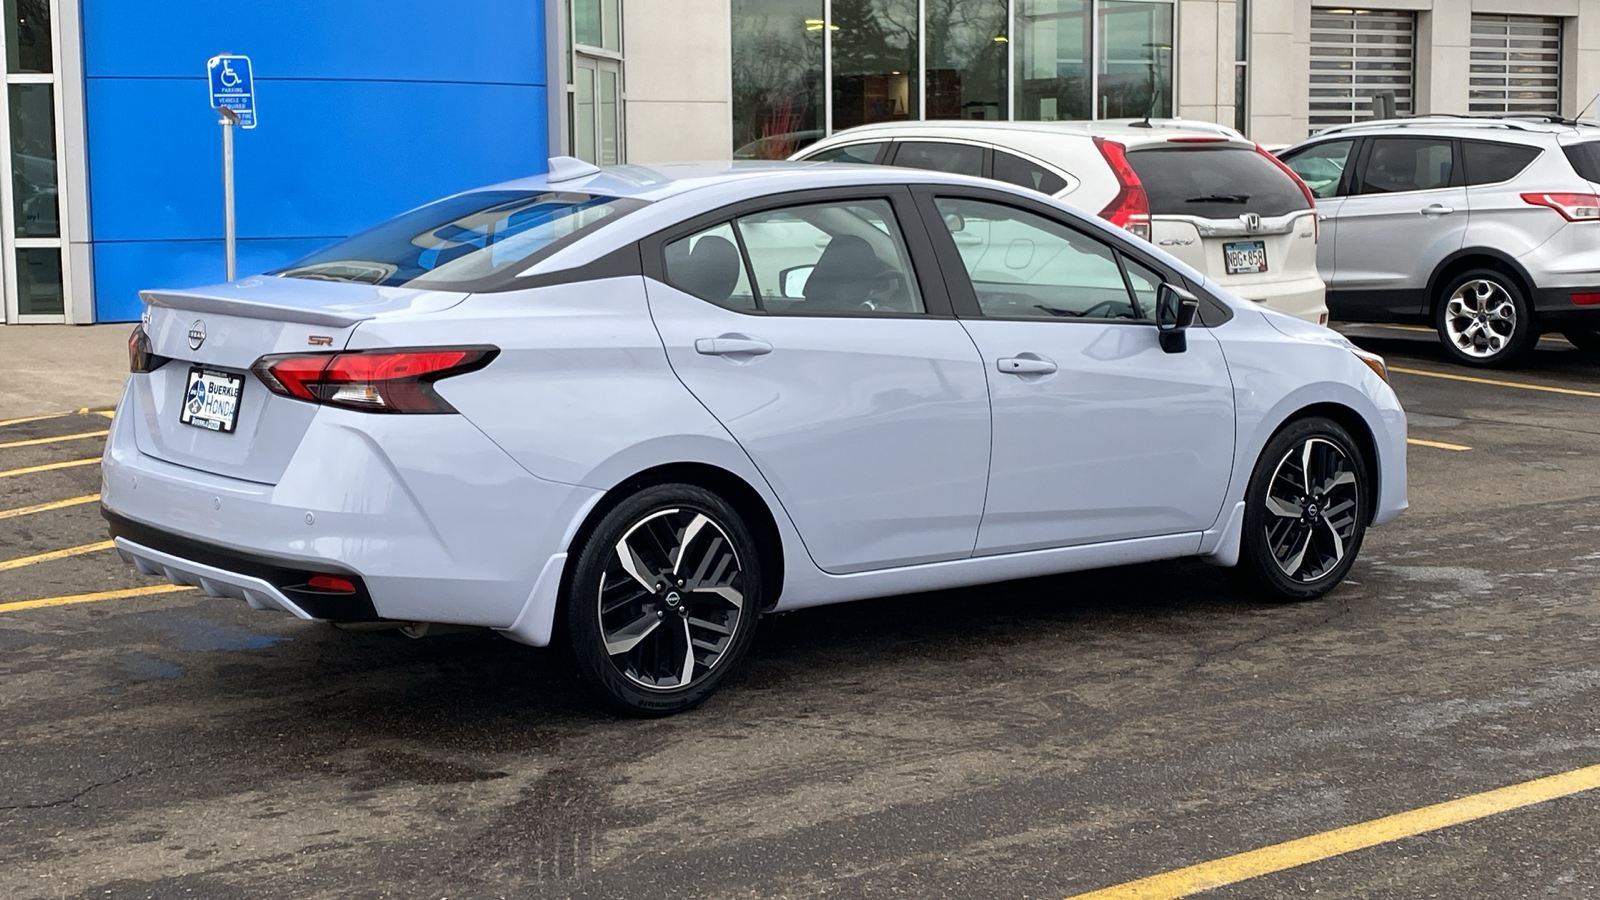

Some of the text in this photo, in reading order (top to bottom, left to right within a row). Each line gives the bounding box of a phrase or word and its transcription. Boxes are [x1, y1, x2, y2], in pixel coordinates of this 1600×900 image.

[1247, 249, 1264, 266] 858
[308, 335, 333, 347] SR
[208, 382, 238, 398] BUERKLE
[205, 394, 235, 416] HONDA
